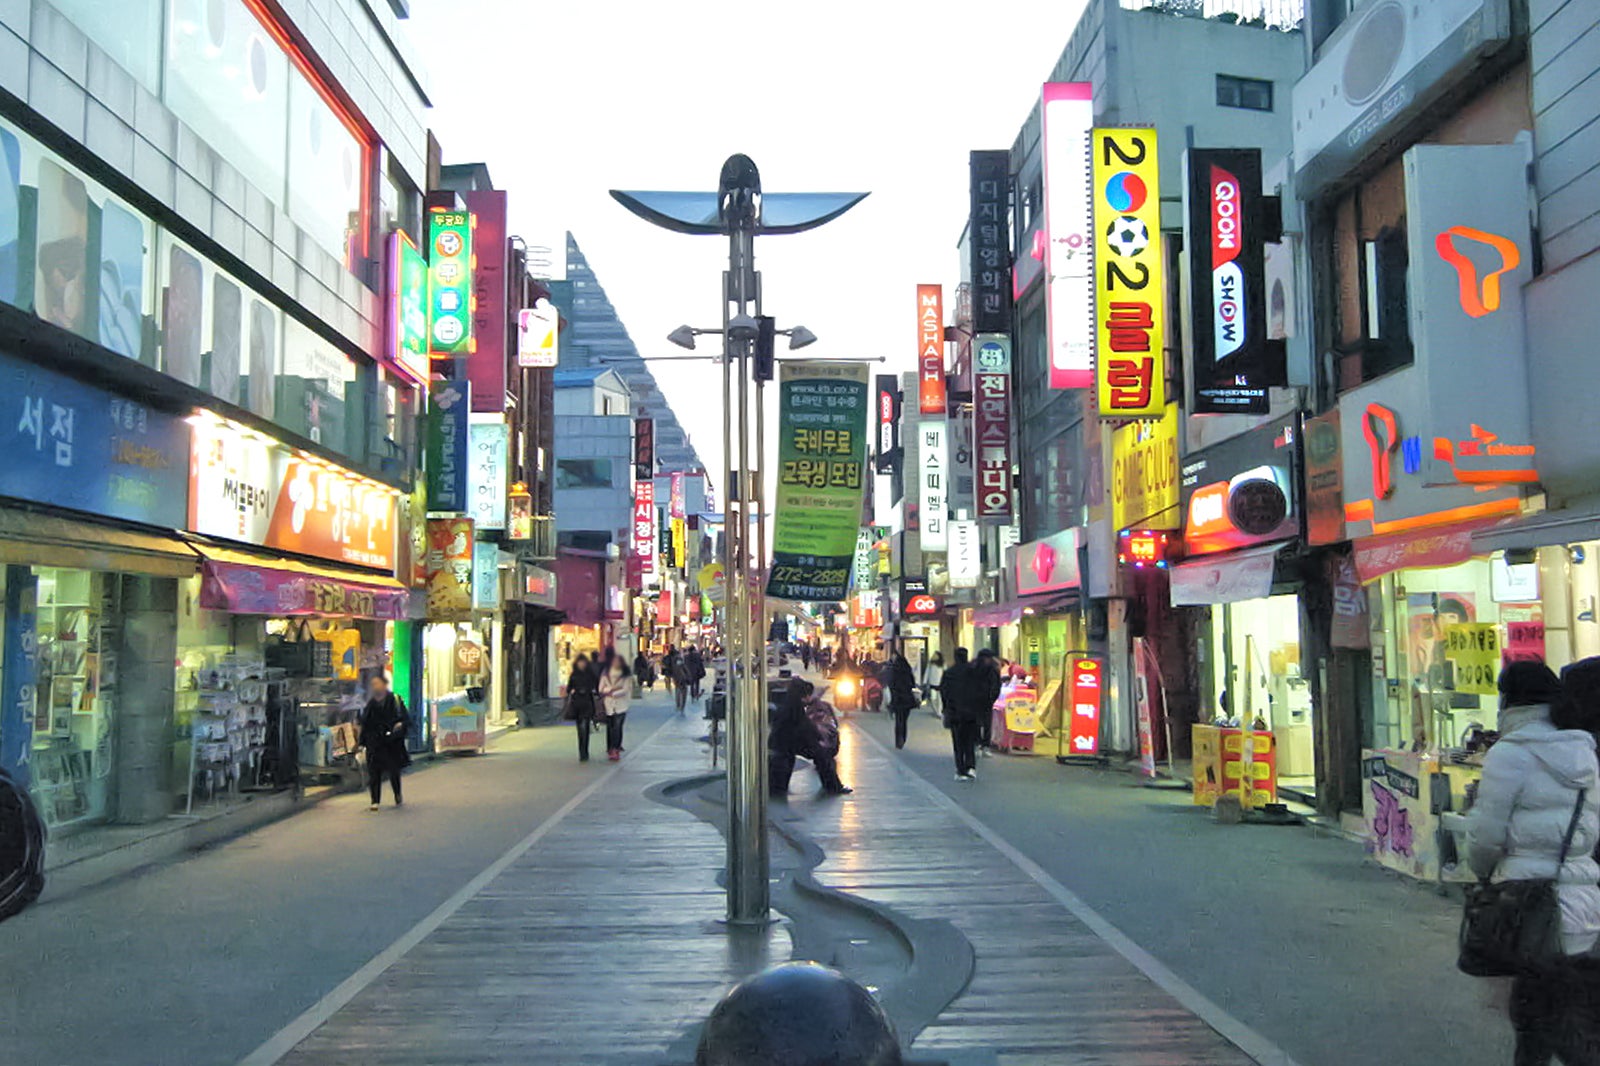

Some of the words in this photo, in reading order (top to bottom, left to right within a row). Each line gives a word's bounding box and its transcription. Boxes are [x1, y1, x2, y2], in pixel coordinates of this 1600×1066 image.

[1215, 181, 1235, 249] QOOK
[1219, 275, 1237, 342] SHOW
[19, 395, 74, 467] 서점
[794, 429, 851, 454] 국비무료
[784, 460, 826, 486] 교육생
[832, 462, 859, 487] 모집
